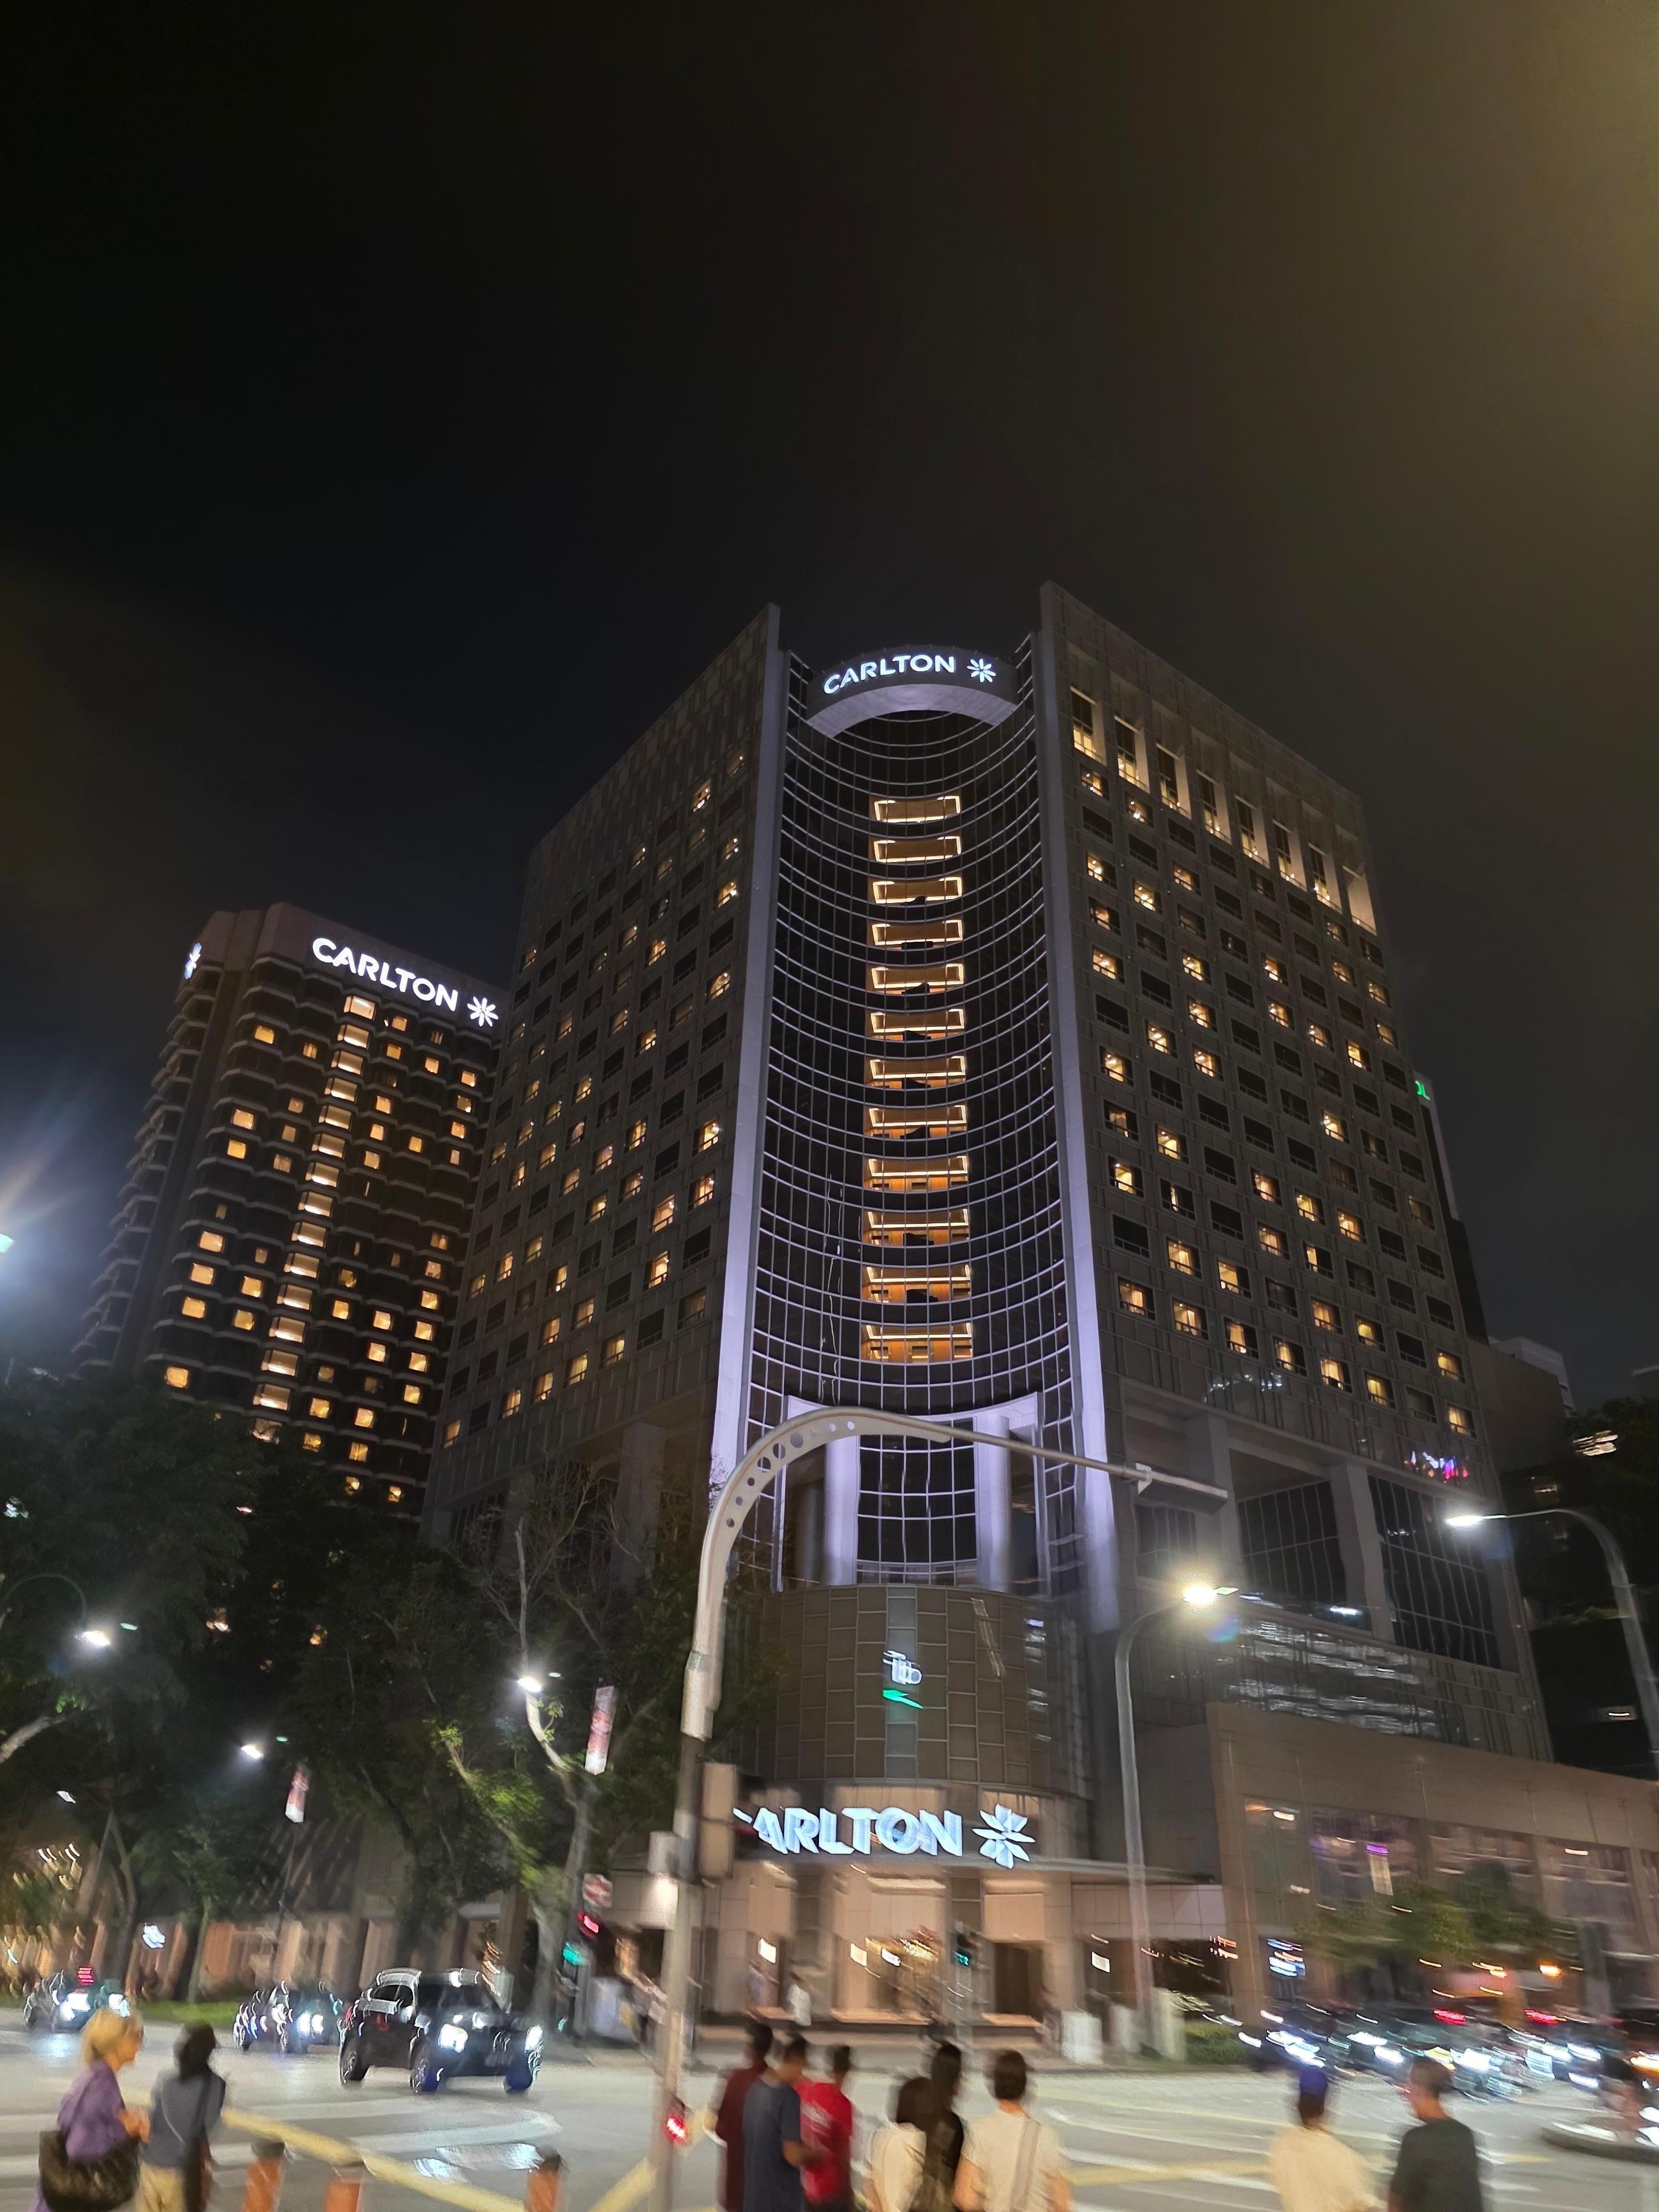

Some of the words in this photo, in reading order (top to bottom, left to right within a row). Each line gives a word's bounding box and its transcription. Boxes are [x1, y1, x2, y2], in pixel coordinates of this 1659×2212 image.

[823, 654, 956, 695] CARLTON
[311, 937, 458, 1013] CARLTON
[733, 1807, 963, 1856] ARLTON
